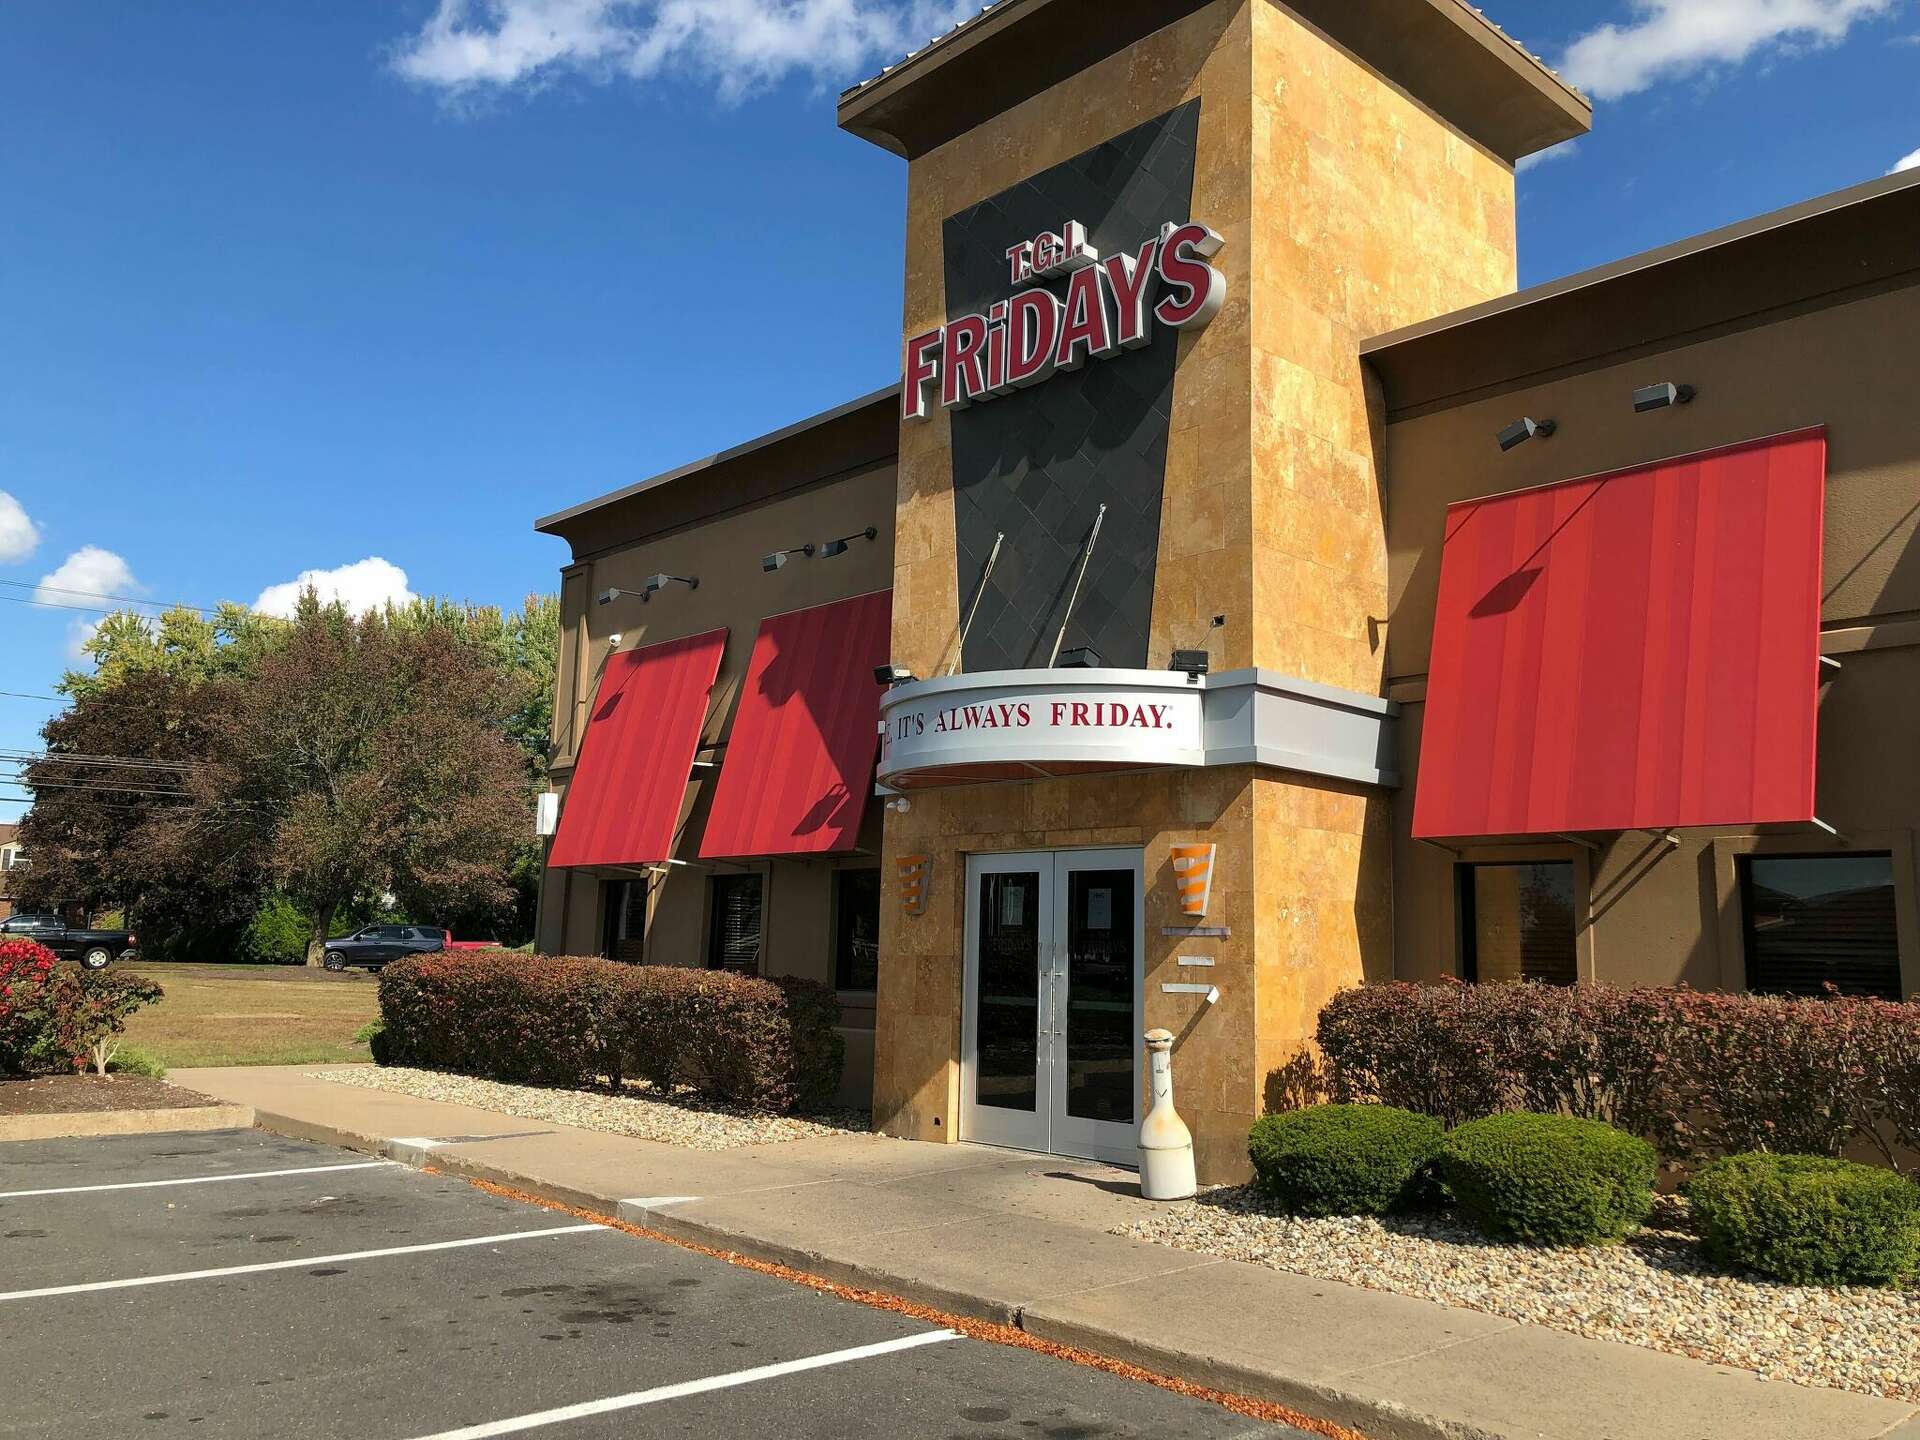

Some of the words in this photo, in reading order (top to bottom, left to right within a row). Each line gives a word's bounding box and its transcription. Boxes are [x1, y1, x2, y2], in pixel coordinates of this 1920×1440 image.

[1006, 219, 1095, 286] T.G.I.
[897, 712, 925, 740] IT'S
[934, 702, 1031, 733] ALWAYS
